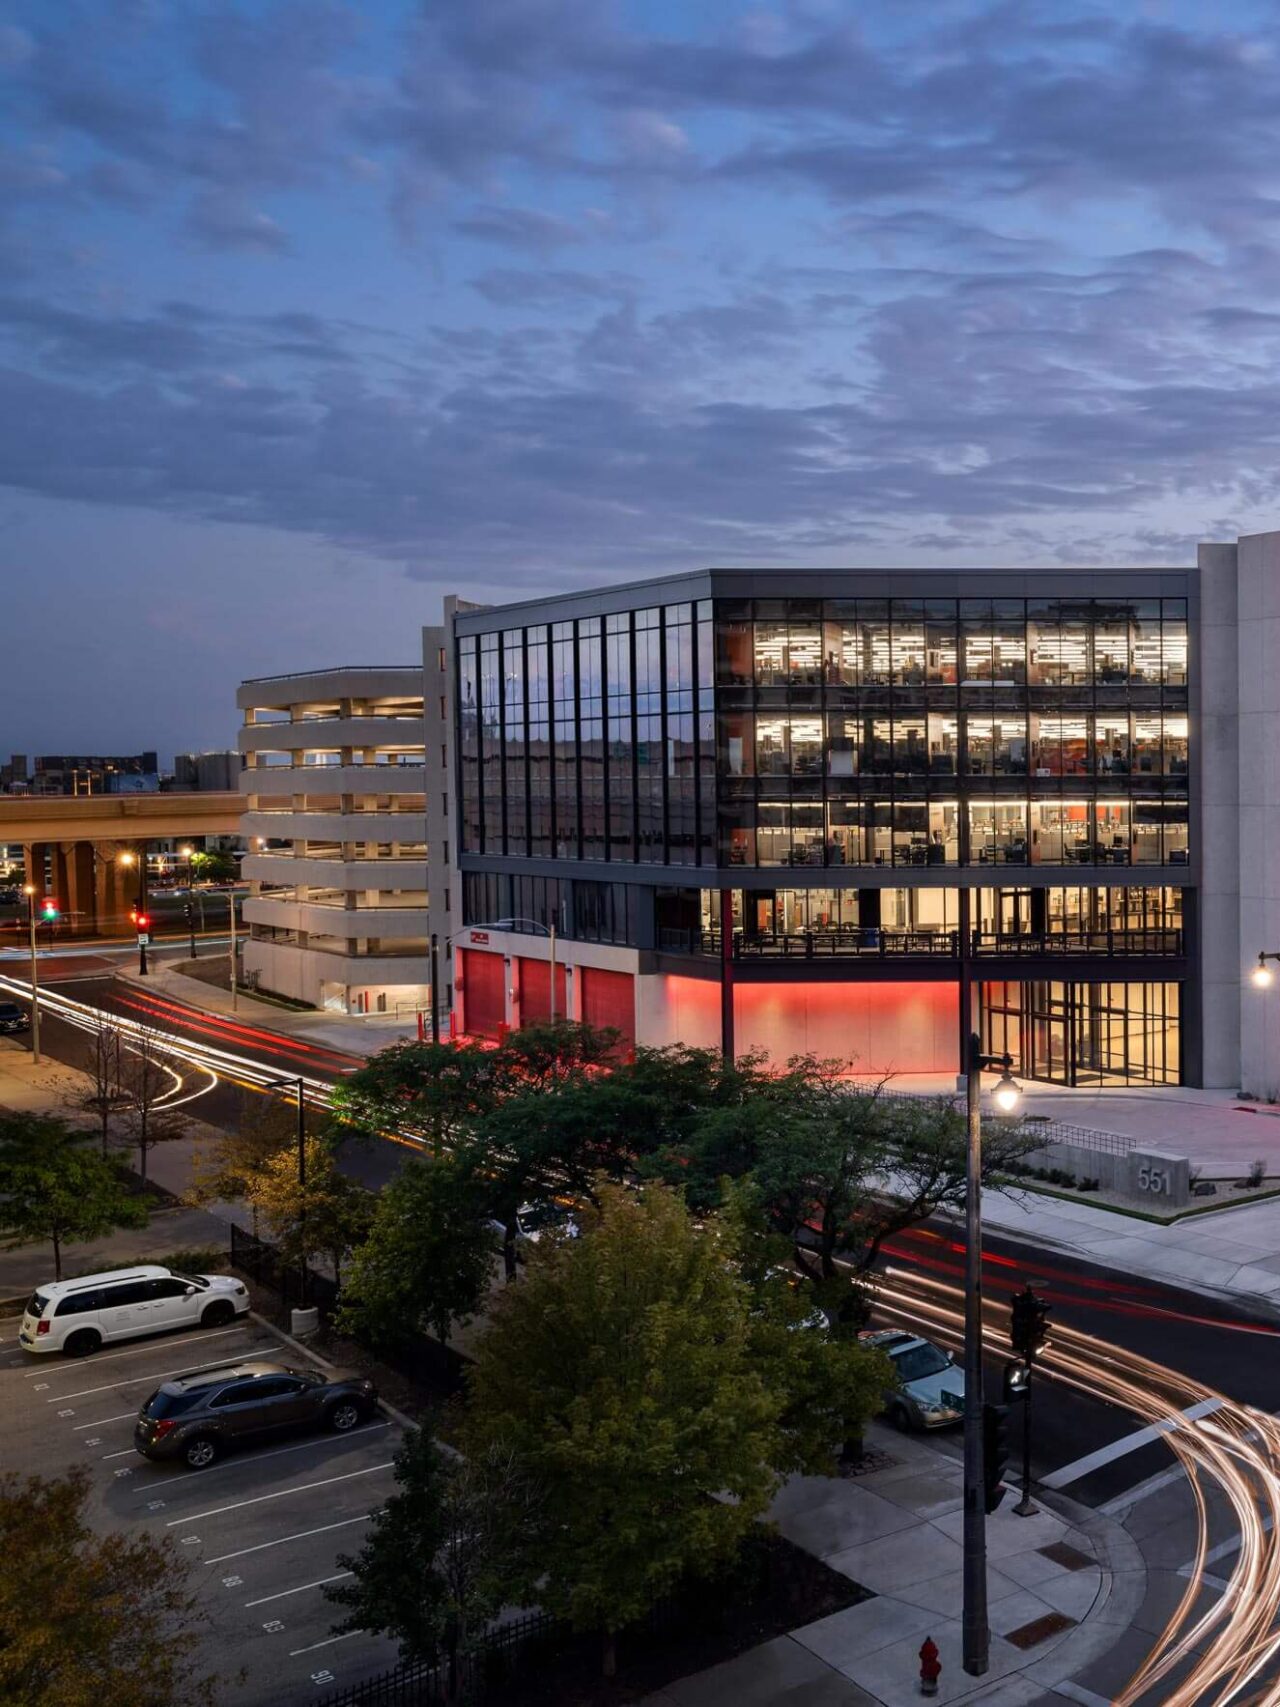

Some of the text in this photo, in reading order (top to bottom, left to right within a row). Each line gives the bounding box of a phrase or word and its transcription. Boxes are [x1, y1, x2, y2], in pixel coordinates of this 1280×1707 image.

[1138, 1167, 1171, 1195] 551
[262, 1621, 285, 1633] 89
[310, 1670, 335, 1684] 90
